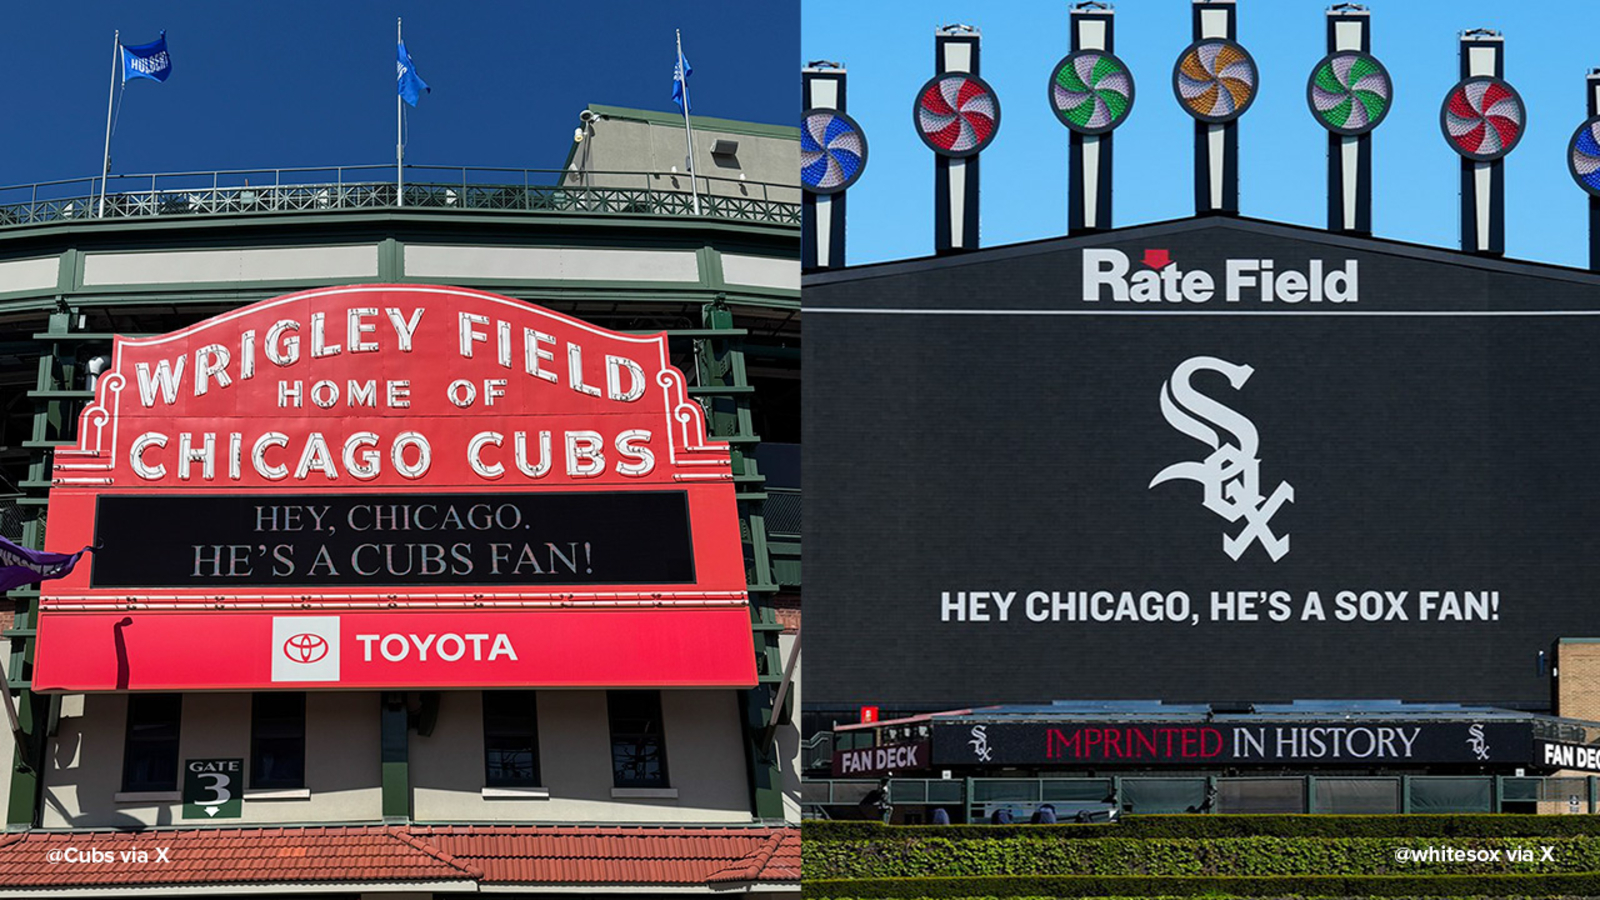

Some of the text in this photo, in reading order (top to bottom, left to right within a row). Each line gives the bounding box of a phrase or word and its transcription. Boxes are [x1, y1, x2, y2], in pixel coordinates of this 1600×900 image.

[1082, 249, 1359, 303] Rate Field
[134, 307, 647, 408] WRIGLEY FIELD
[277, 378, 507, 409] HOME OF
[129, 429, 656, 480] CHICAGO CUBS
[254, 504, 531, 534] HEY, CHICAGO.
[191, 542, 593, 577] HE’S A CUBS FAN!
[941, 590, 1500, 626] HEY CHICAGO, HE’S A SOX FAN!
[355, 633, 519, 662] TOYOTA
[1045, 727, 1422, 759] IMPRINTED IN HISTORY
[1544, 743, 1574, 768] FAN
[189, 761, 240, 772] GATE
[841, 745, 918, 774] FAN DECK
[194, 773, 231, 806] 3
